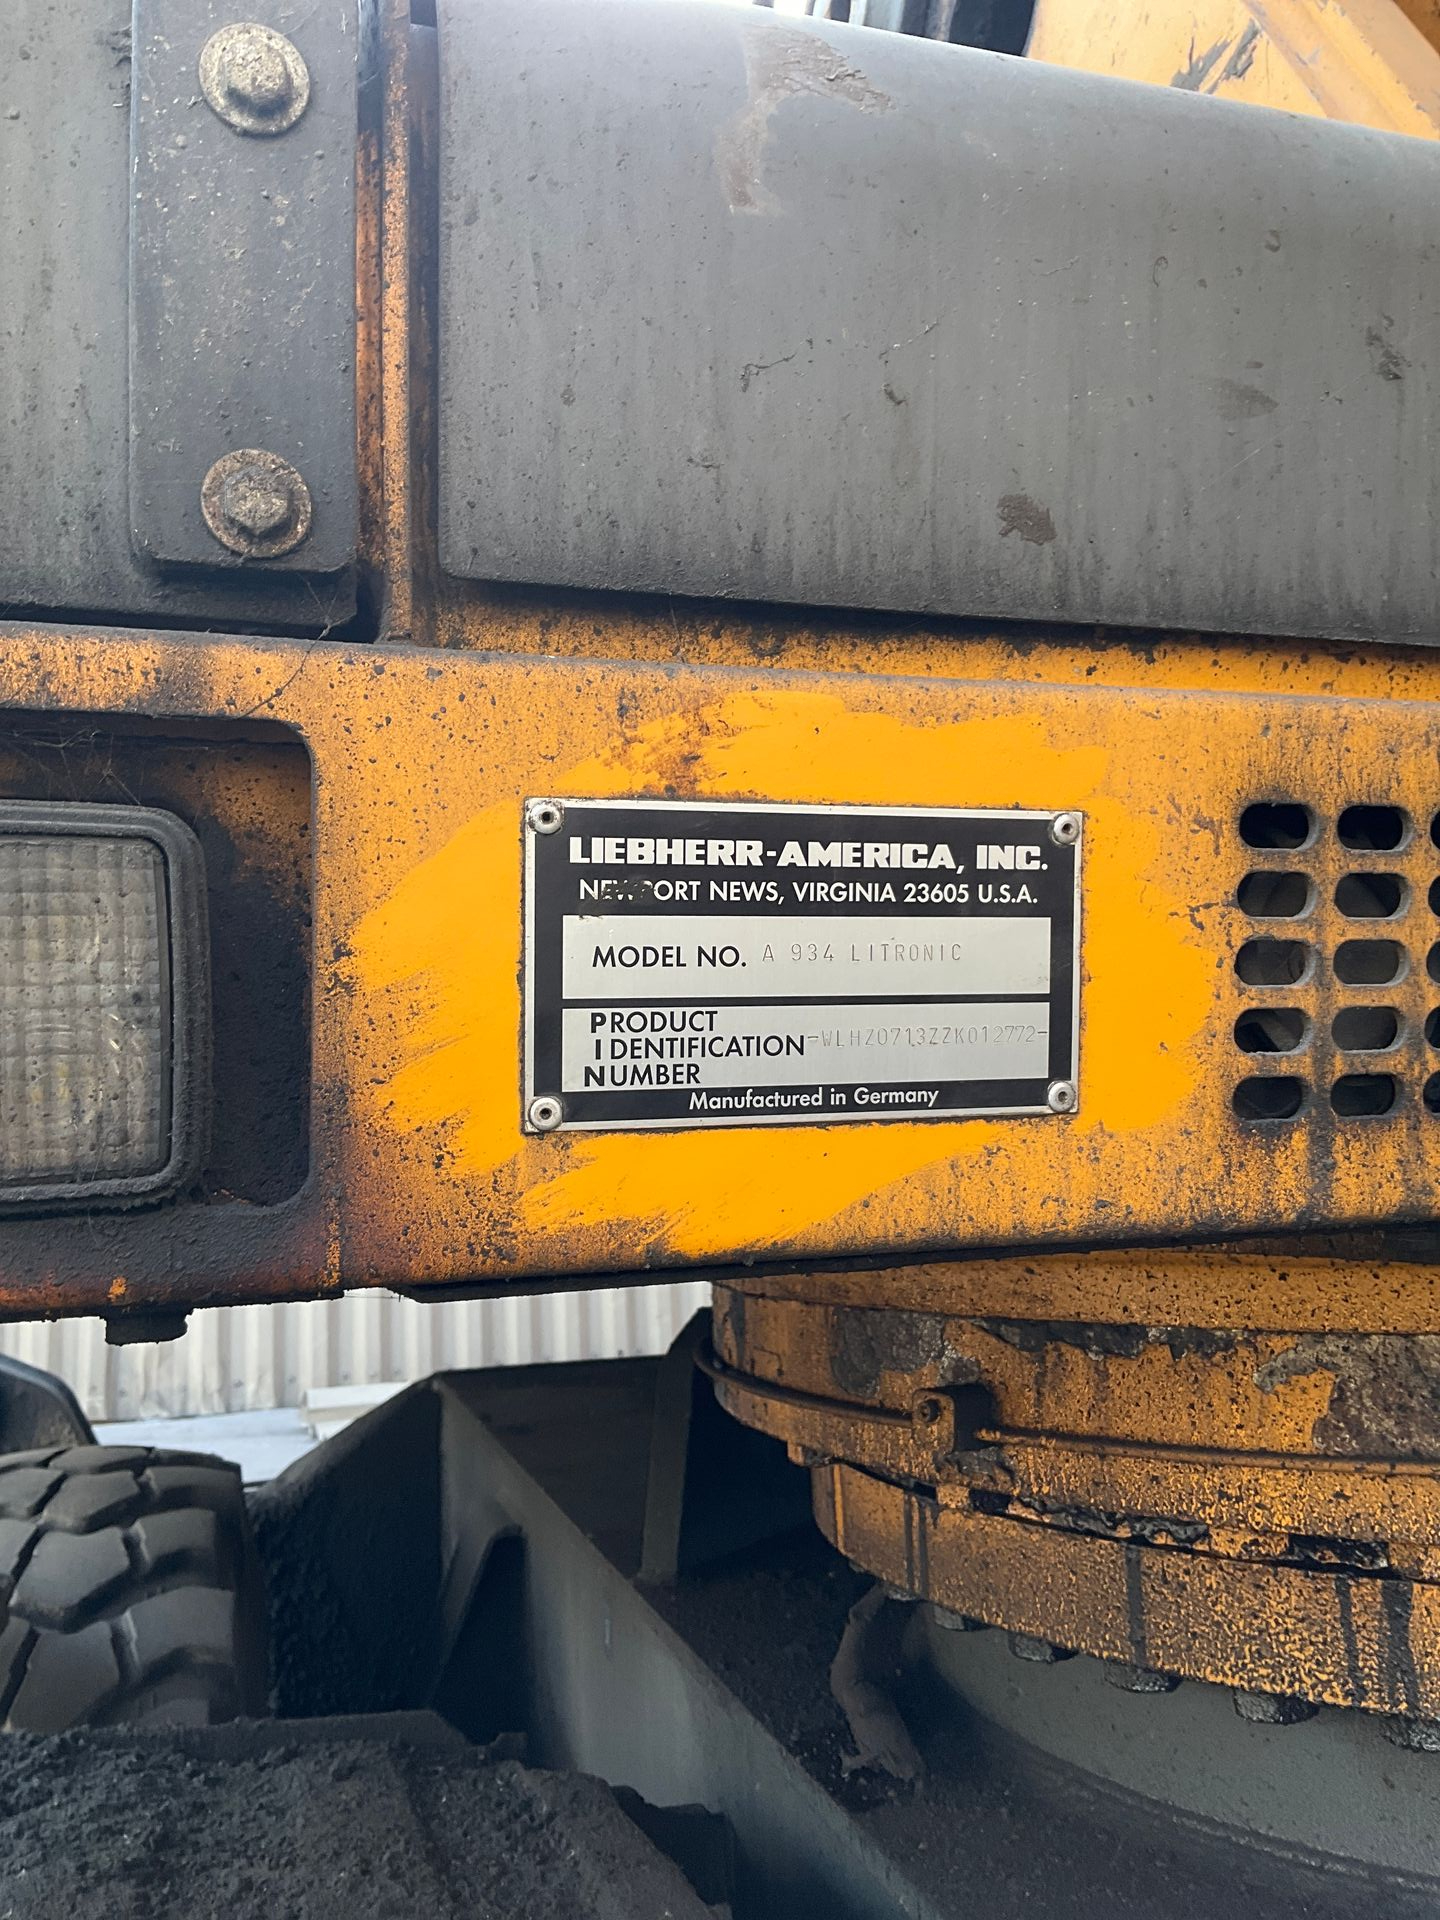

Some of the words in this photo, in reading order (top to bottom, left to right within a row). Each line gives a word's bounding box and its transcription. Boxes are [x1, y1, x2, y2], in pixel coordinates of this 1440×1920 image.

[569, 836, 965, 875] LIEBHERR-AMERICA,
[976, 844, 1049, 871] INC.
[709, 880, 785, 905] NEWS,
[792, 881, 897, 903] VIRGINIA
[903, 882, 970, 903] 23605
[977, 883, 1039, 904] U.S.A.
[592, 945, 687, 968] MODEL
[697, 945, 747, 968] NO.
[762, 943, 775, 962] A
[791, 943, 835, 962] 934
[851, 943, 962, 962] LITRONIC
[590, 1010, 718, 1034] PRODUCT
[595, 1034, 805, 1060] IDENTIFICATION
[583, 1063, 701, 1087] NUMBER
[688, 1086, 823, 1110] Manufactured
[830, 1088, 847, 1106] in
[853, 1086, 940, 1107] Germany
